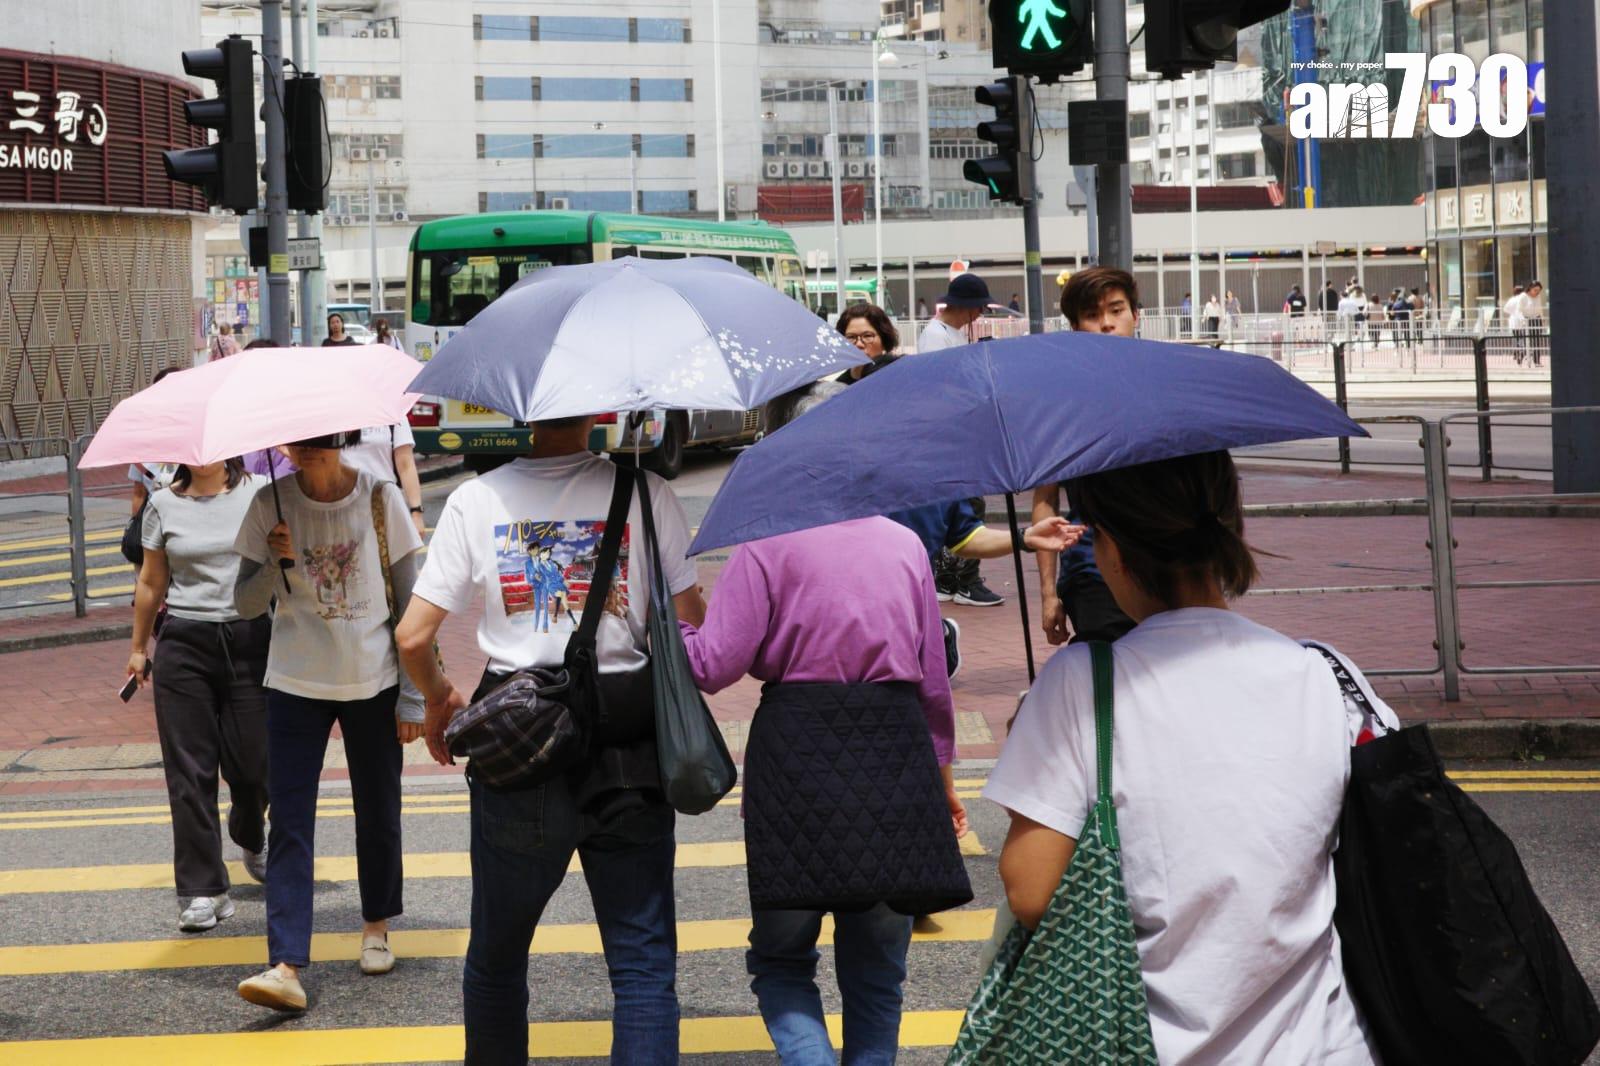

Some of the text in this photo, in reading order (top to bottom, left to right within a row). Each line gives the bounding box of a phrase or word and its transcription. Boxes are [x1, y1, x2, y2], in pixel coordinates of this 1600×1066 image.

[9, 91, 84, 142] 三哥
[0, 144, 73, 171] SAMGOR
[473, 438, 518, 446] 2751 6666
[1319, 650, 1366, 703] BEAM
